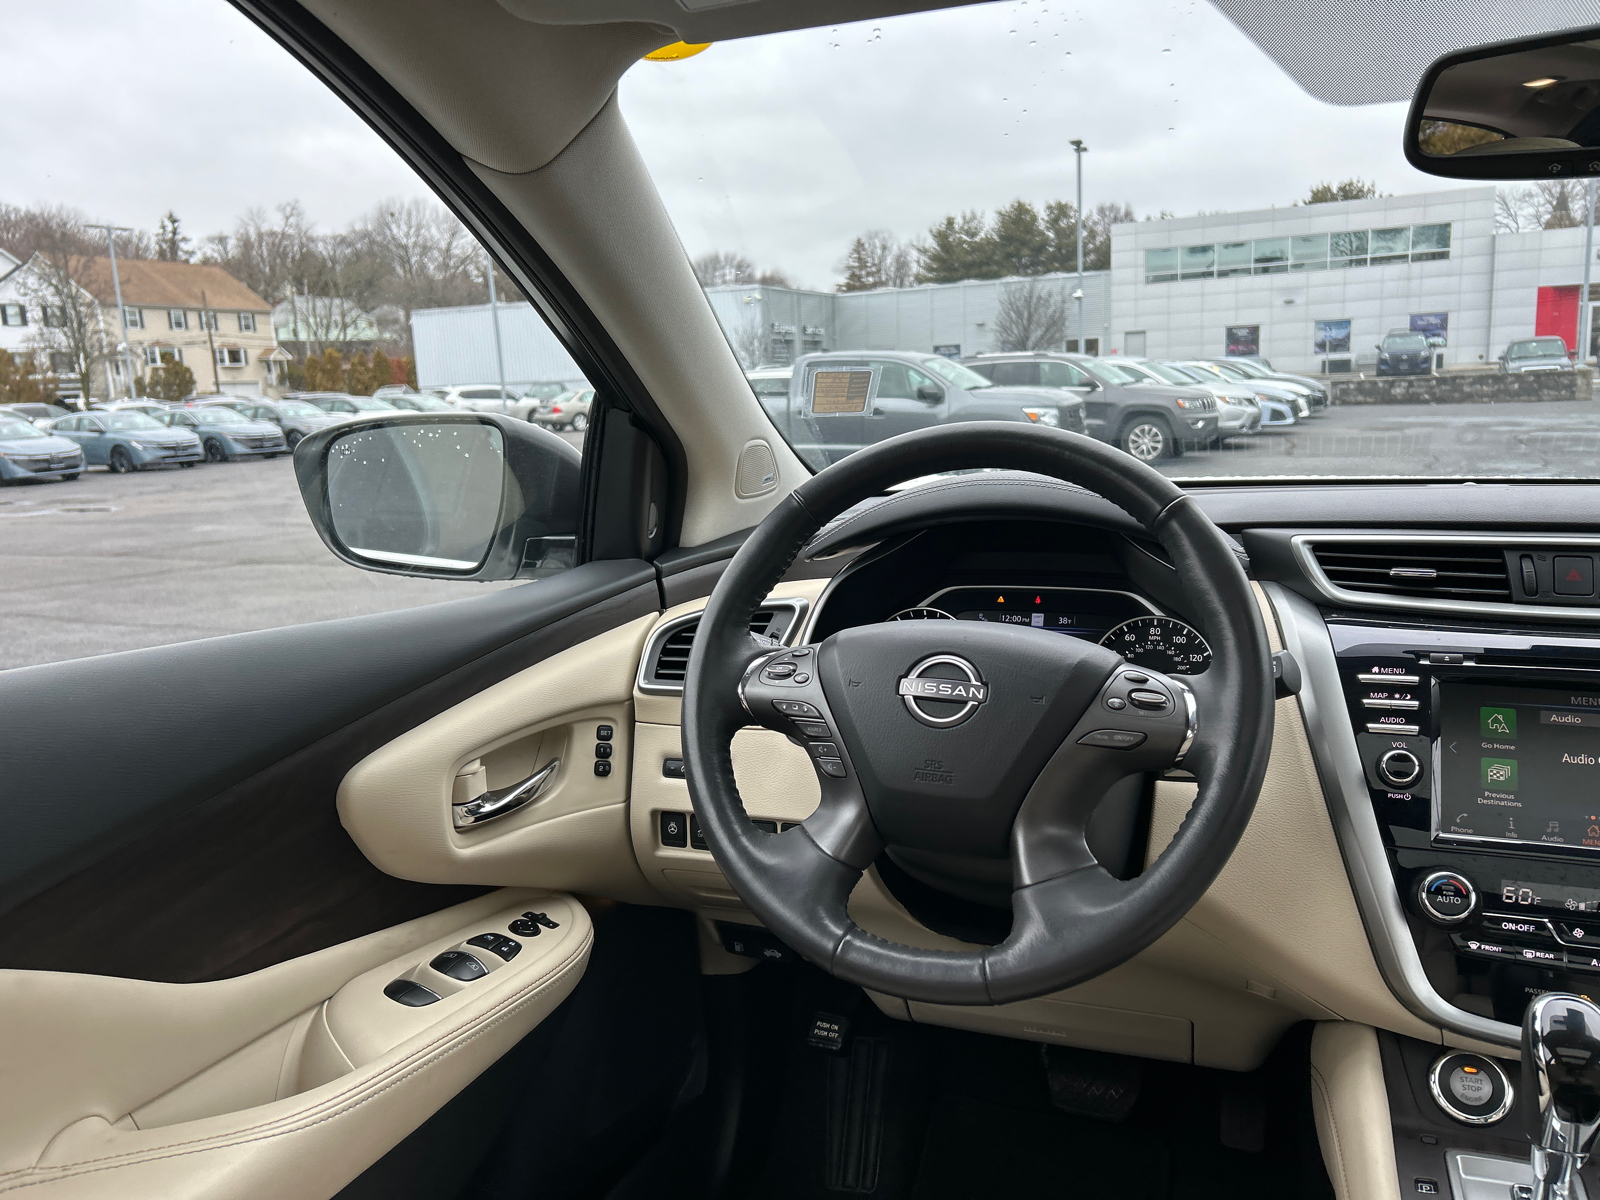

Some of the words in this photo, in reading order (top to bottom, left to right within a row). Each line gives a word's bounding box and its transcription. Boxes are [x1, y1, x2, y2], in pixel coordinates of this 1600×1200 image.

[1001, 614, 1022, 623] 12:00
[1149, 627, 1161, 635] 80
[1124, 634, 1136, 642] 60
[1172, 636, 1187, 644] 100
[1189, 654, 1203, 662] 120
[1380, 667, 1406, 675] MENU
[902, 681, 984, 700] NISSAN
[1379, 716, 1406, 724] AUDIO
[1550, 714, 1582, 724] Audio
[1391, 741, 1408, 749] VOL
[1493, 743, 1516, 751] Home
[1562, 753, 1596, 765] Audio
[924, 759, 944, 770] SRS
[914, 770, 954, 785] AIRBAG
[1484, 791, 1515, 800] Previous
[1477, 797, 1523, 808] Destinations
[1450, 825, 1474, 834] Phone
[1505, 831, 1518, 839] Info
[1541, 834, 1564, 843] Audio
[1436, 895, 1461, 905] AUTO
[1536, 951, 1555, 959] REAR
[816, 1021, 830, 1029] PUSH
[813, 1029, 828, 1037] PUSH
[1460, 1076, 1483, 1085] START
[1461, 1084, 1482, 1093] STOP
